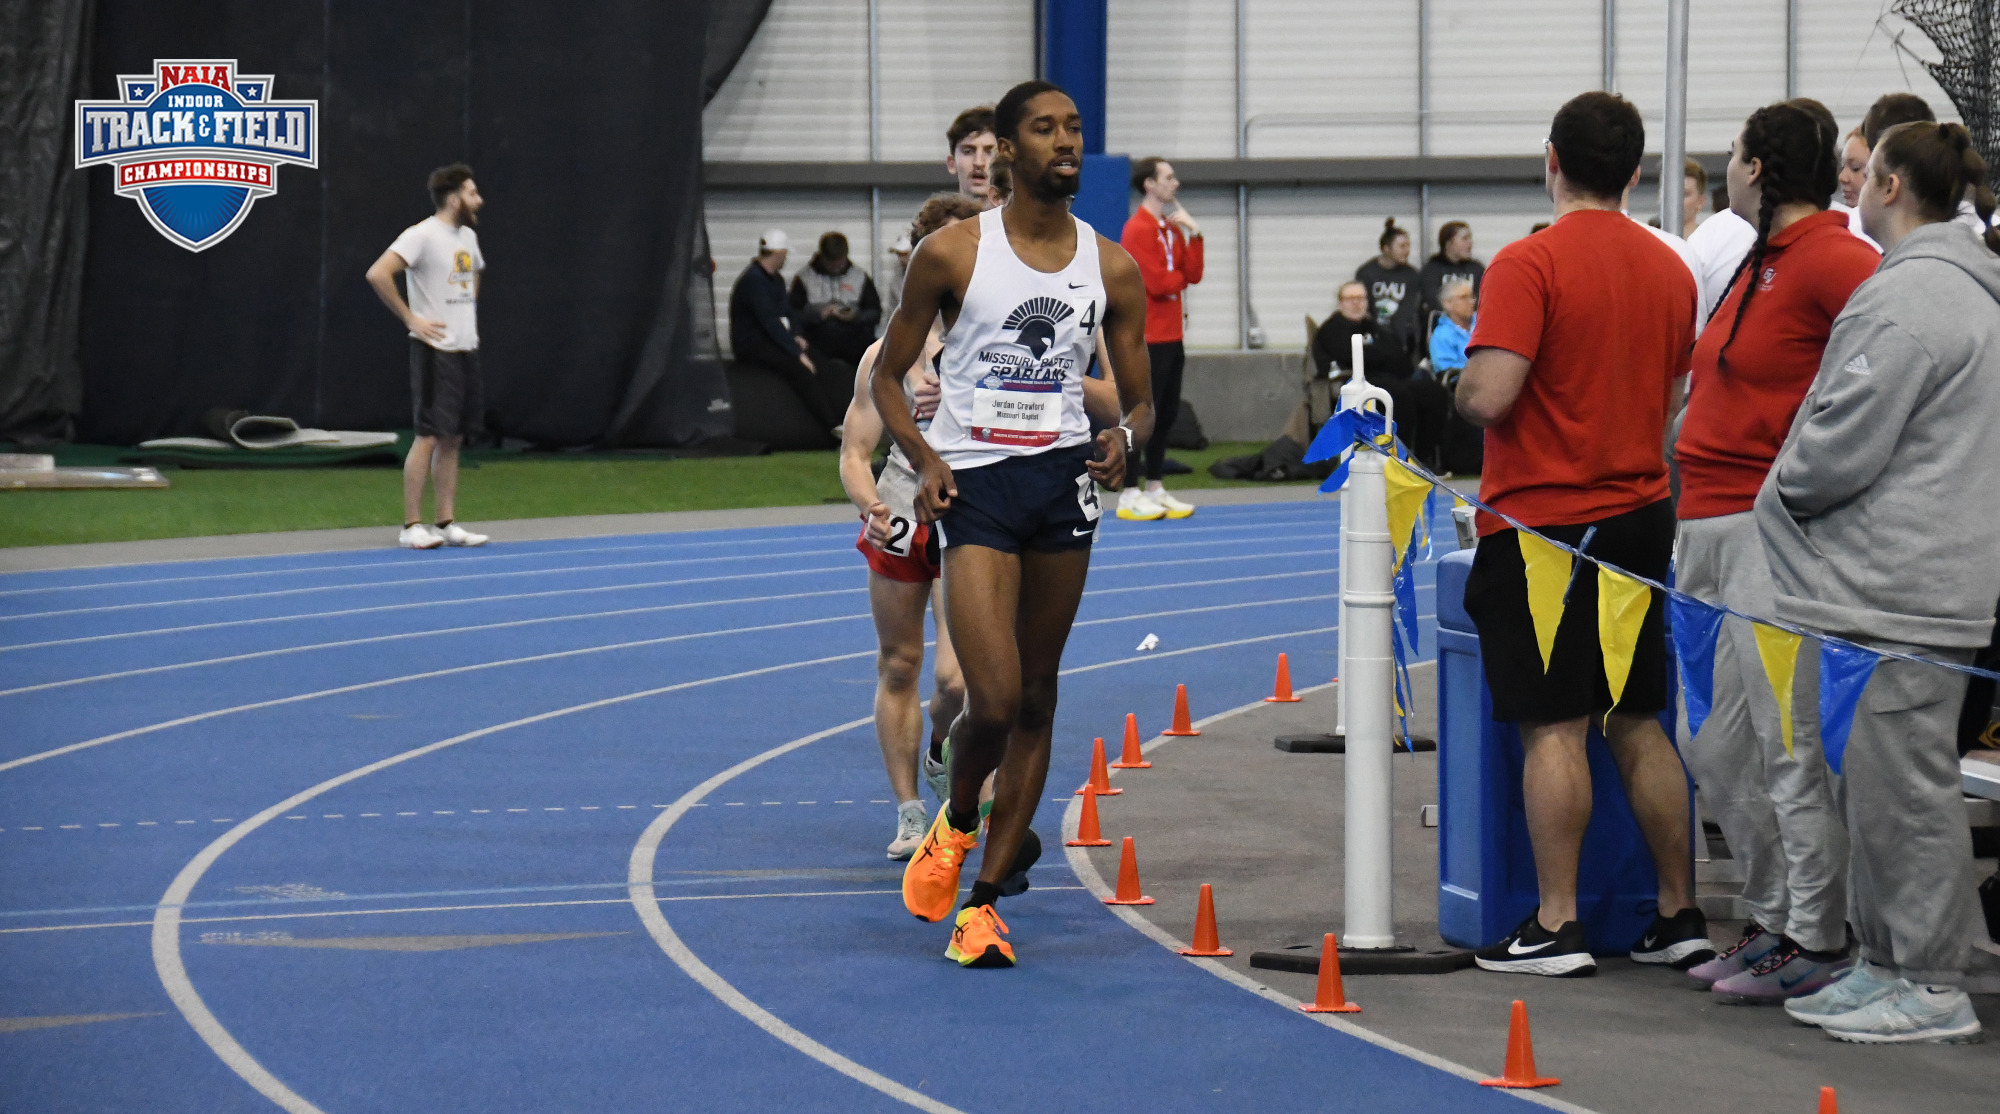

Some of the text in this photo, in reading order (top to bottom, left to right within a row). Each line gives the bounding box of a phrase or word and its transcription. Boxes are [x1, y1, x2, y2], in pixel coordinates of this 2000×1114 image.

[1079, 299, 1095, 335] 4
[978, 351, 1075, 370] MISSOURI BAPTIST
[989, 365, 1067, 381] SPARTANS
[992, 400, 1045, 411] Jordan Crawford
[996, 411, 1020, 419] Missouri
[1083, 480, 1099, 510] 4
[885, 516, 910, 555] 2
